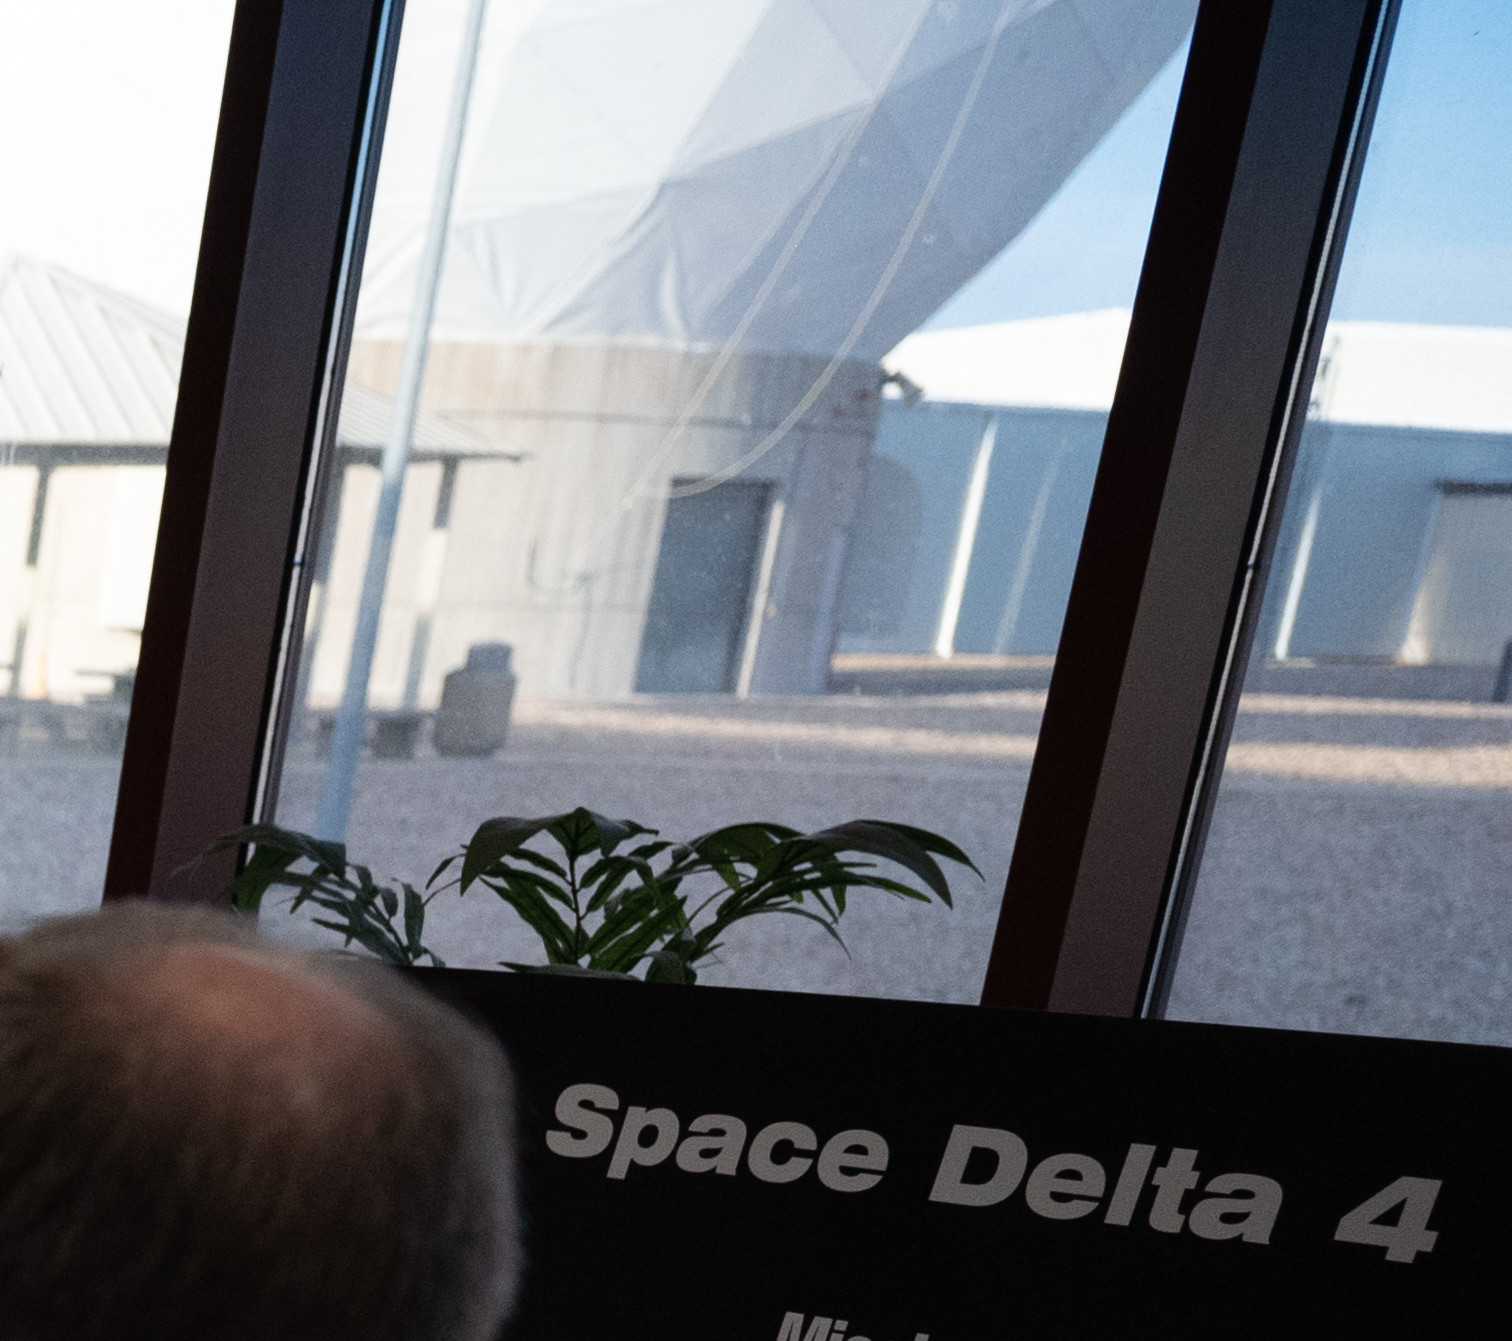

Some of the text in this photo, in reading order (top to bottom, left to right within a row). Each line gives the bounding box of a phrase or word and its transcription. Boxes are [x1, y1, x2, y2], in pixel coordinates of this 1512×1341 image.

[546, 1081, 1443, 1266] Space Delta 4
